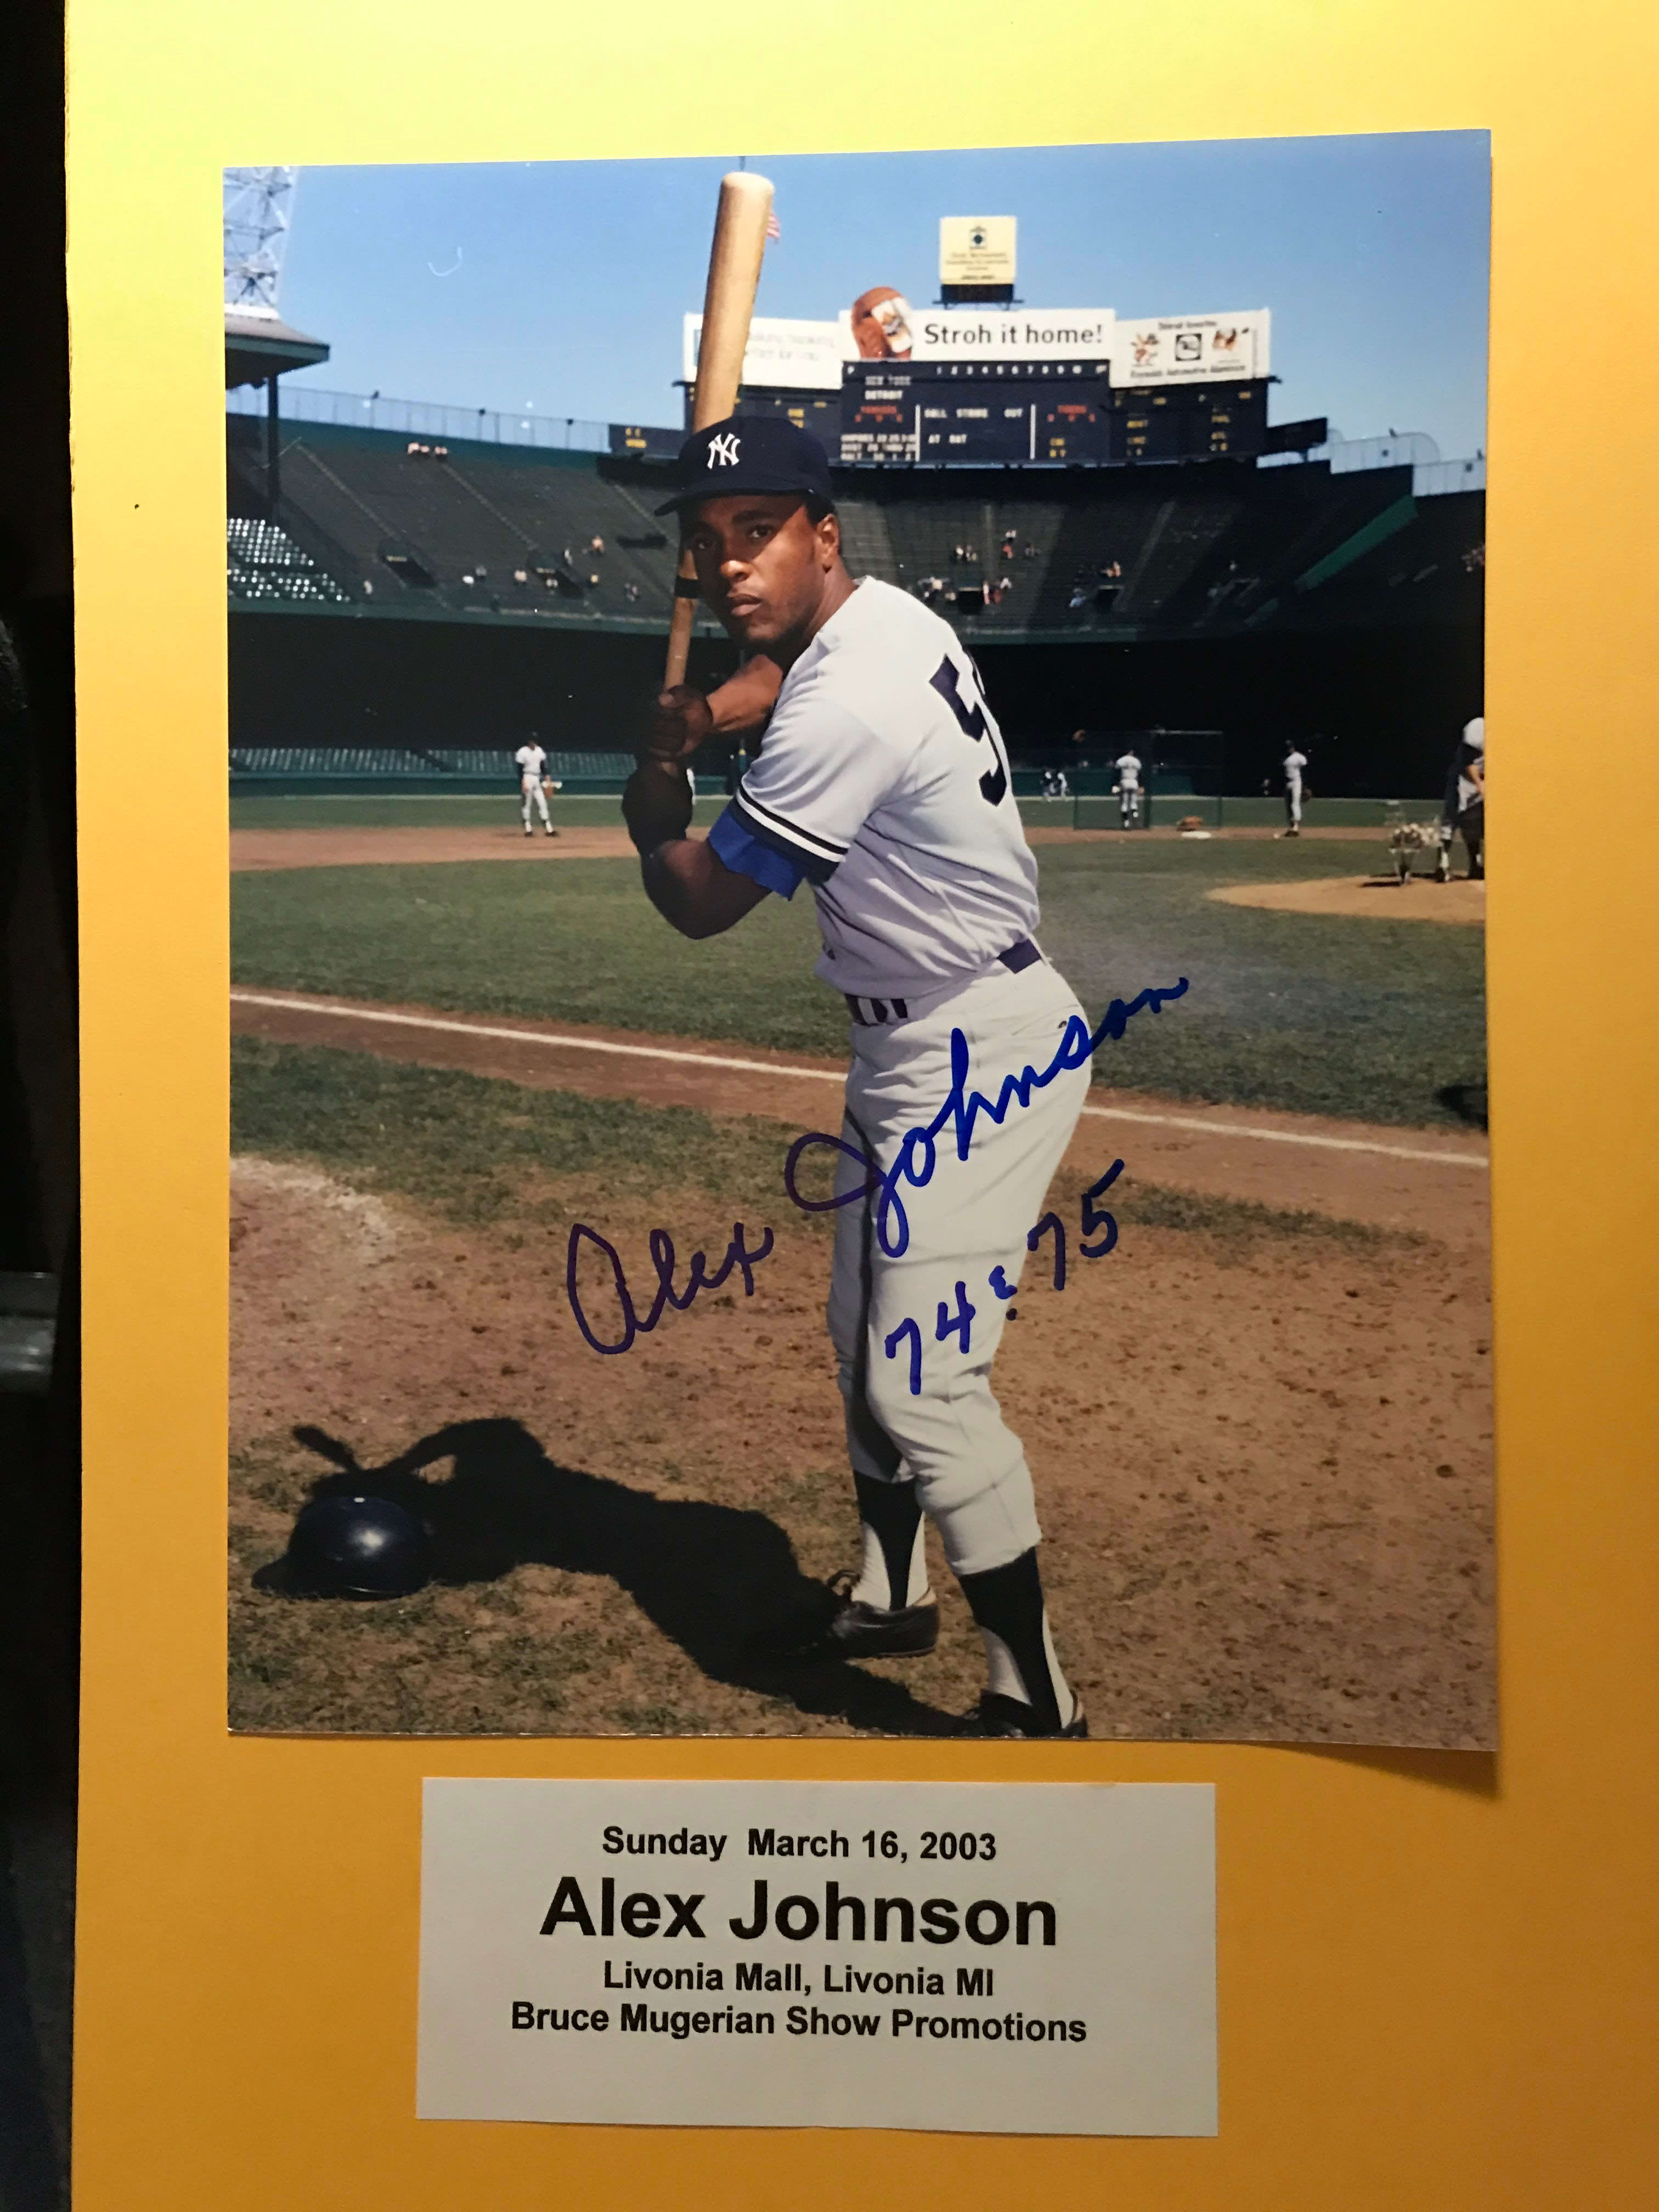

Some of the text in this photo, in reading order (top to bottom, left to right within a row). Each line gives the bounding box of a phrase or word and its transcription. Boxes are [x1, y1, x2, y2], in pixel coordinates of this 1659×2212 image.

[924, 323, 1103, 345] Stroh it home!
[707, 432, 741, 470] NY
[929, 652, 1007, 807] 5
[567, 976, 1189, 1355] Alex Johnson
[885, 1282, 975, 1395] 74
[1027, 1159, 1125, 1291] 75
[602, 1826, 996, 1864] Sunday March 16, 2003
[539, 1876, 1056, 1946] Alex Johnson
[604, 1960, 993, 1996] Livonia Mall, Livonia MI
[512, 2001, 1087, 2042] Bruce Mugerian Show Promotions
